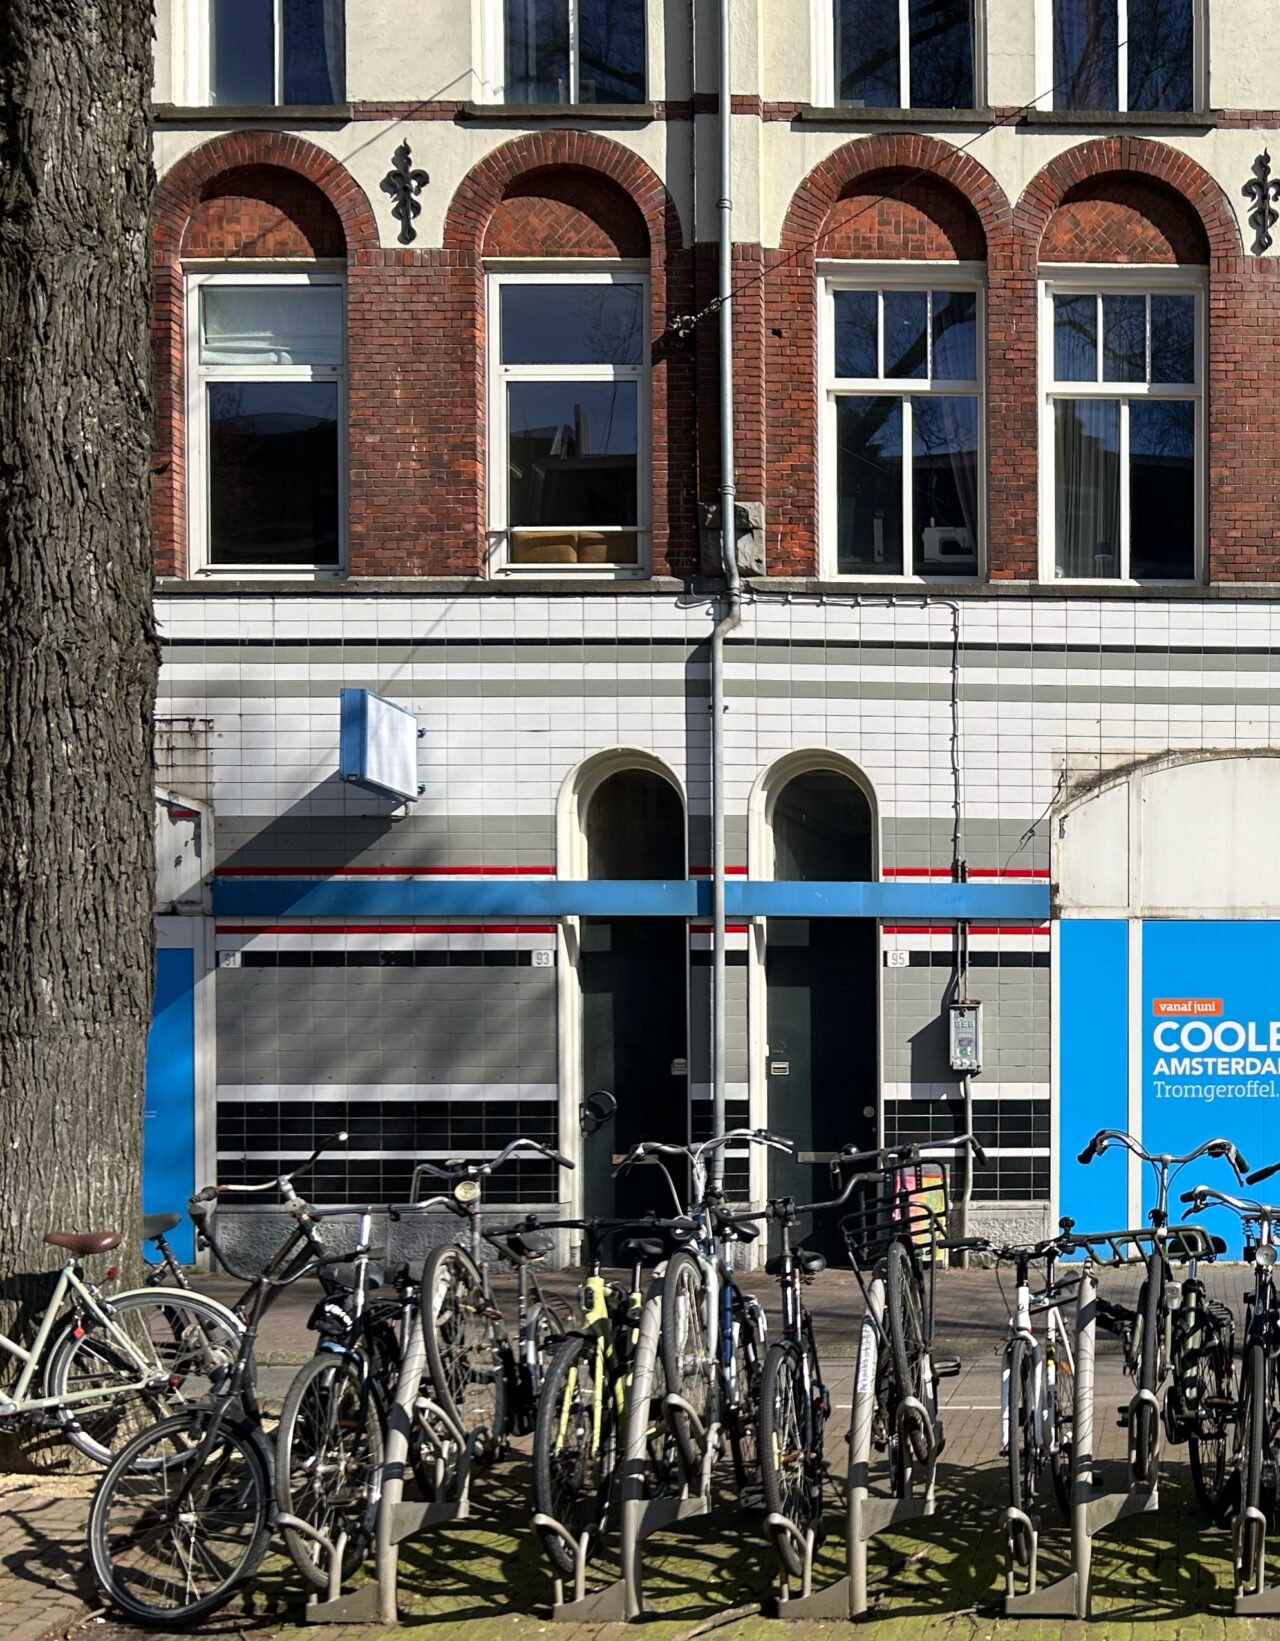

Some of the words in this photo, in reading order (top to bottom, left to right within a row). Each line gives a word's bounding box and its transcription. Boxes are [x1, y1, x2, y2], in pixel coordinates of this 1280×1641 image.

[536, 951, 550, 965] 93
[891, 952, 905, 966] 95
[1158, 1000, 1193, 1013] vanaf
[1193, 1000, 1216, 1014] juni
[1153, 1080, 1280, 1102] Tromgeroffel.
